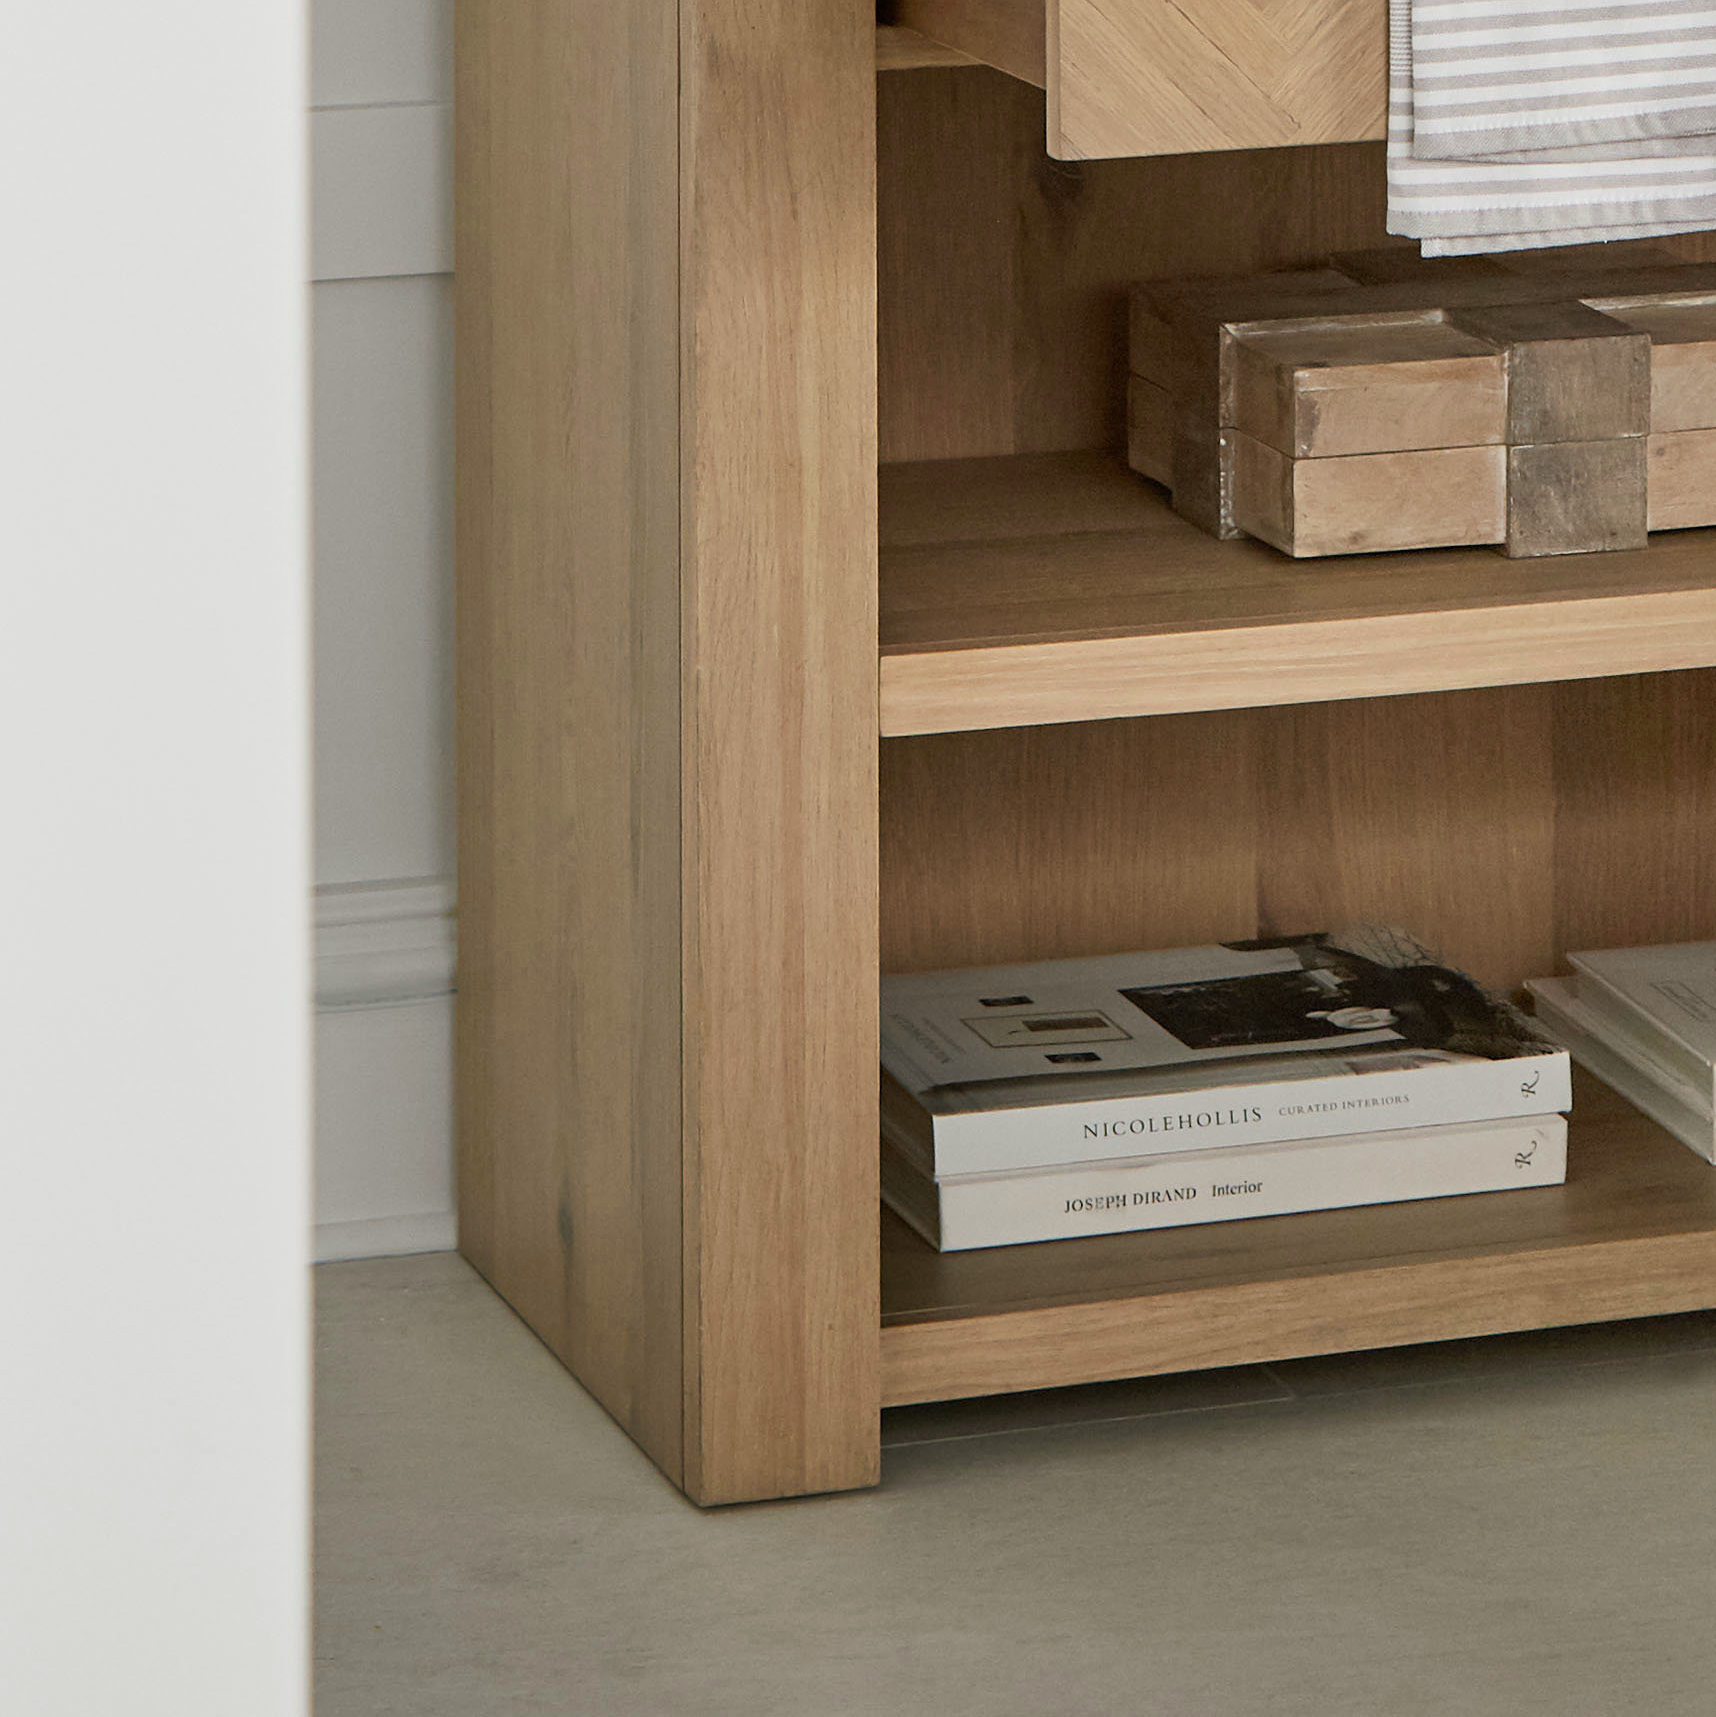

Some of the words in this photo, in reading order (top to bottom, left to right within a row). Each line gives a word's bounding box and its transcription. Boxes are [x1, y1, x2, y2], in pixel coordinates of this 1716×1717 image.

[1278, 1102, 1338, 1117] CURATED
[1342, 1095, 1410, 1109] INTERIORS
[1083, 1107, 1263, 1139] NICOLEHOLLIS
[1064, 1194, 1127, 1214] JOSEPH
[1133, 1187, 1197, 1207] DIRAND
[1211, 1180, 1264, 1198] Interior
